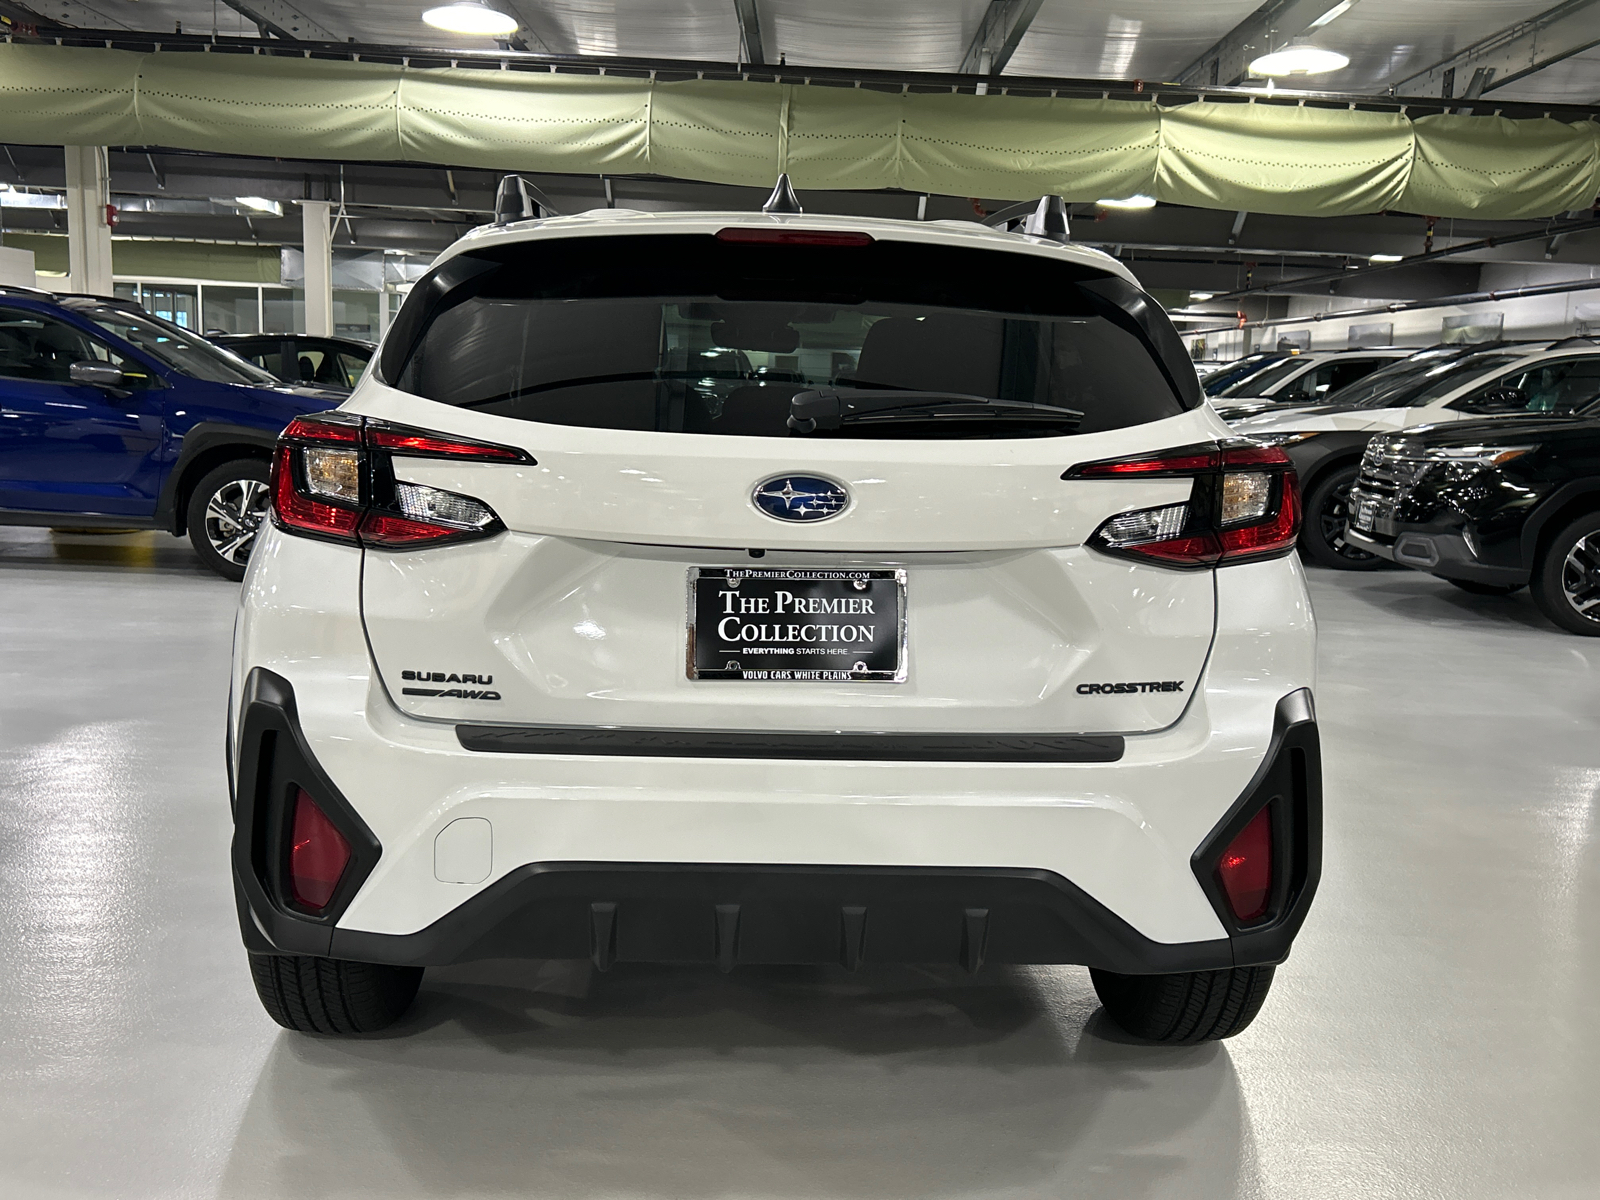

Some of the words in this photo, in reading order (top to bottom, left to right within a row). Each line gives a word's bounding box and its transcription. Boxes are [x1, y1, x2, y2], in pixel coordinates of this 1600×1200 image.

[724, 569, 870, 579] THEPREMIERCOLLECTION.COM
[718, 590, 770, 614] THE
[774, 590, 875, 615] PREMIER
[717, 616, 876, 642] COLLECTION
[401, 670, 493, 685] SUBARU
[742, 671, 768, 680] VOLVO
[770, 671, 791, 680] CARS
[794, 671, 820, 680] WHITE
[823, 671, 852, 680] PLAINS
[1076, 681, 1184, 694] CROSSTREK
[438, 689, 501, 700] AWD
